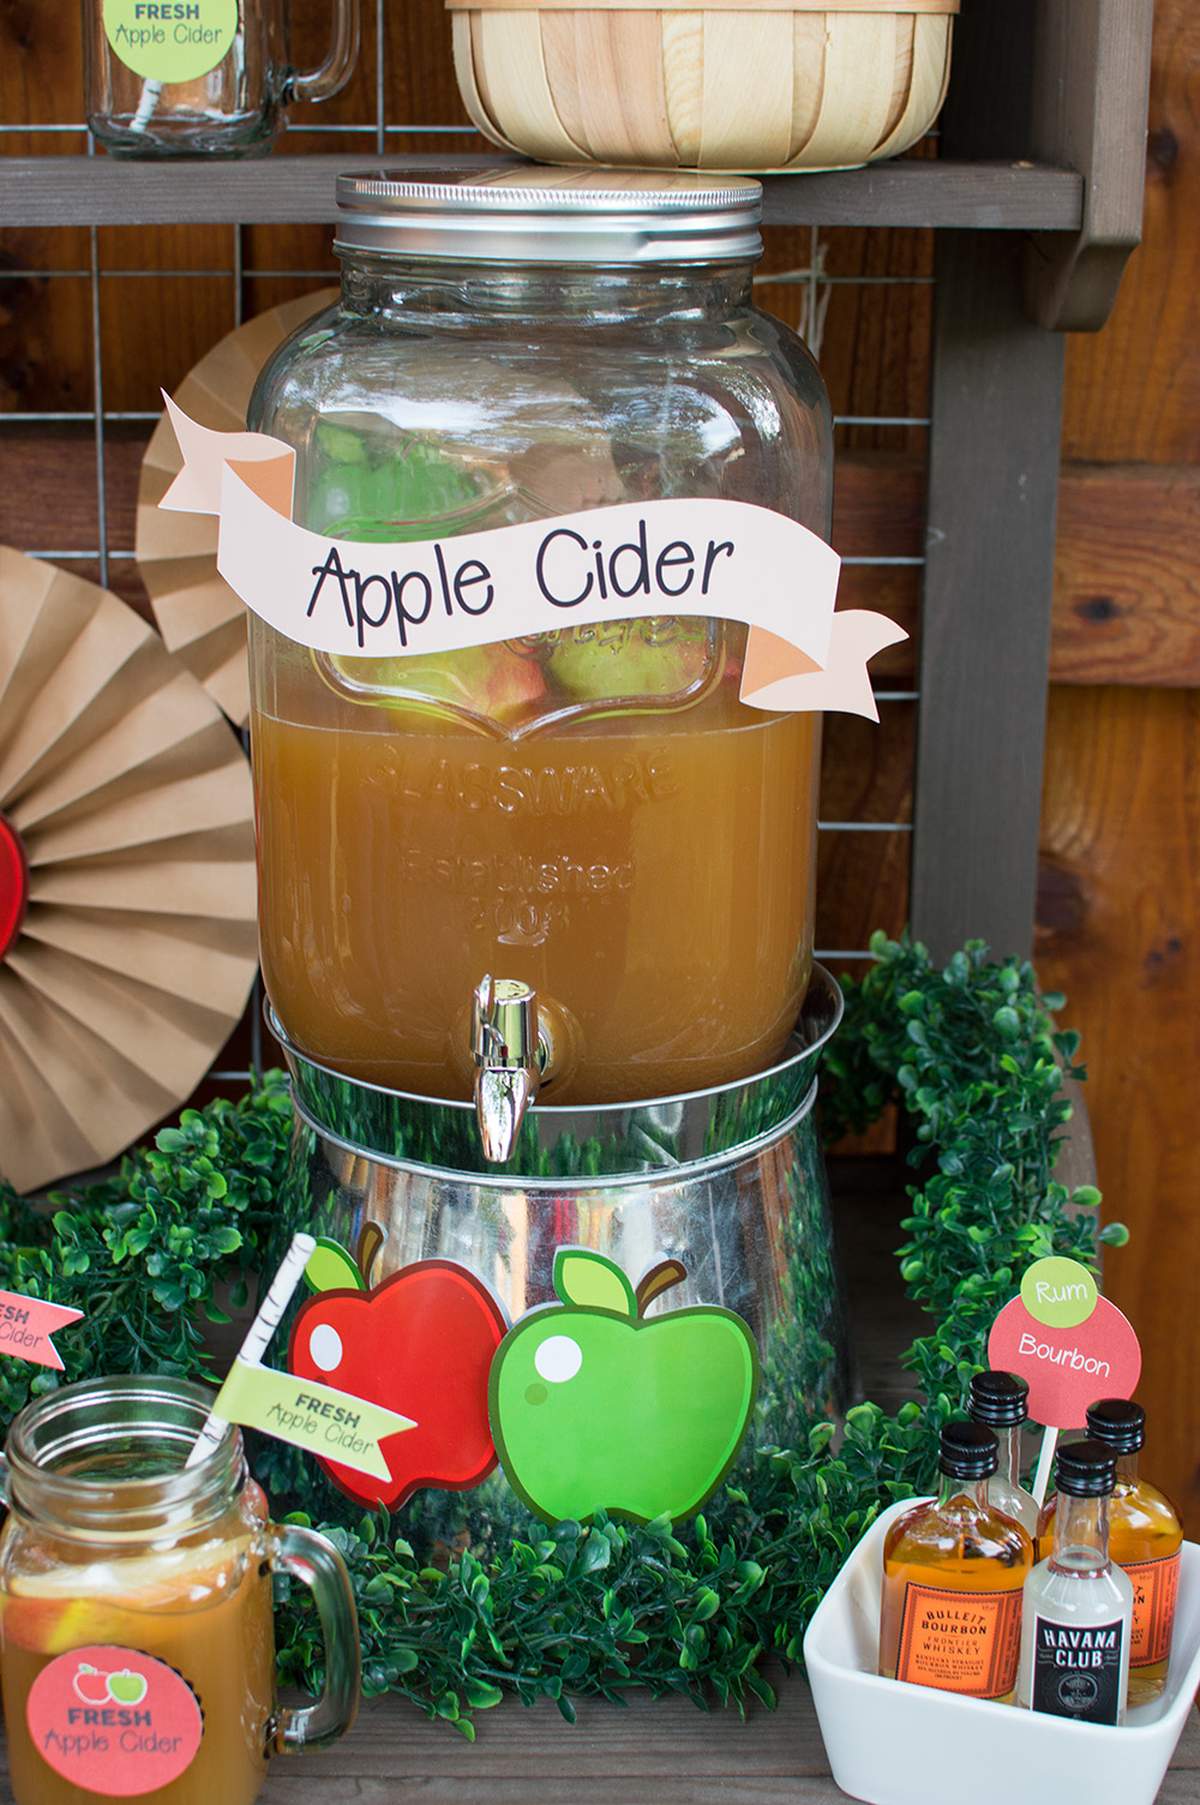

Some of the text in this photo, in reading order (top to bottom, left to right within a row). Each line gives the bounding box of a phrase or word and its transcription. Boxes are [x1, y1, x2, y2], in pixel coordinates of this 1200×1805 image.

[135, 4, 200, 20] FRESH
[115, 23, 223, 48] Apple Cider
[305, 518, 735, 648] Apple Cider
[1035, 1281, 1088, 1303] Rum
[0, 1302, 30, 1325] ESH
[1018, 1332, 1111, 1378] Bourbon
[295, 1393, 362, 1429] FRESH
[266, 1402, 374, 1455] Apple Cider
[921, 1620, 987, 1635] BOURBON
[926, 1610, 986, 1626] BULLEIT
[922, 1641, 980, 1655] WHISKEY
[1043, 1629, 1117, 1649] HAVANA
[1055, 1649, 1103, 1668] CLUB
[67, 1708, 152, 1726] FRESH
[44, 1728, 182, 1757] Apple Cider
